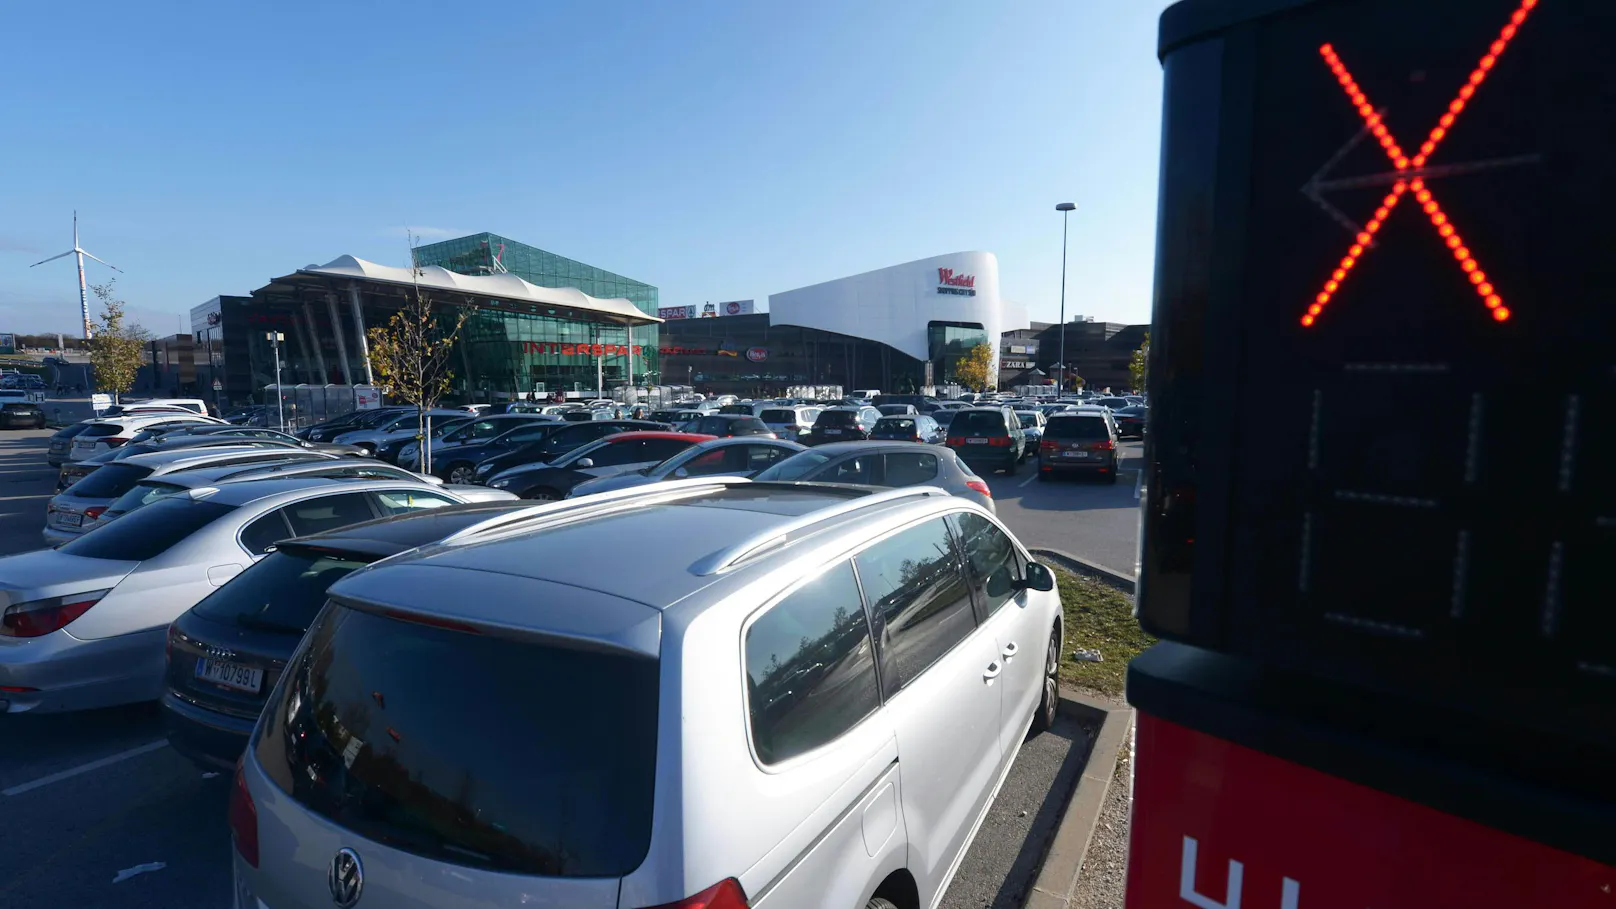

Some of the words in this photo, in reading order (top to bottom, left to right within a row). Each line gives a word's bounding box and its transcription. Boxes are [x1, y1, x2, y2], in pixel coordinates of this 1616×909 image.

[938, 267, 975, 287] Westfield
[704, 301, 715, 312] dm
[523, 342, 642, 357] INTERSPAR
[1006, 361, 1025, 369] ZARA
